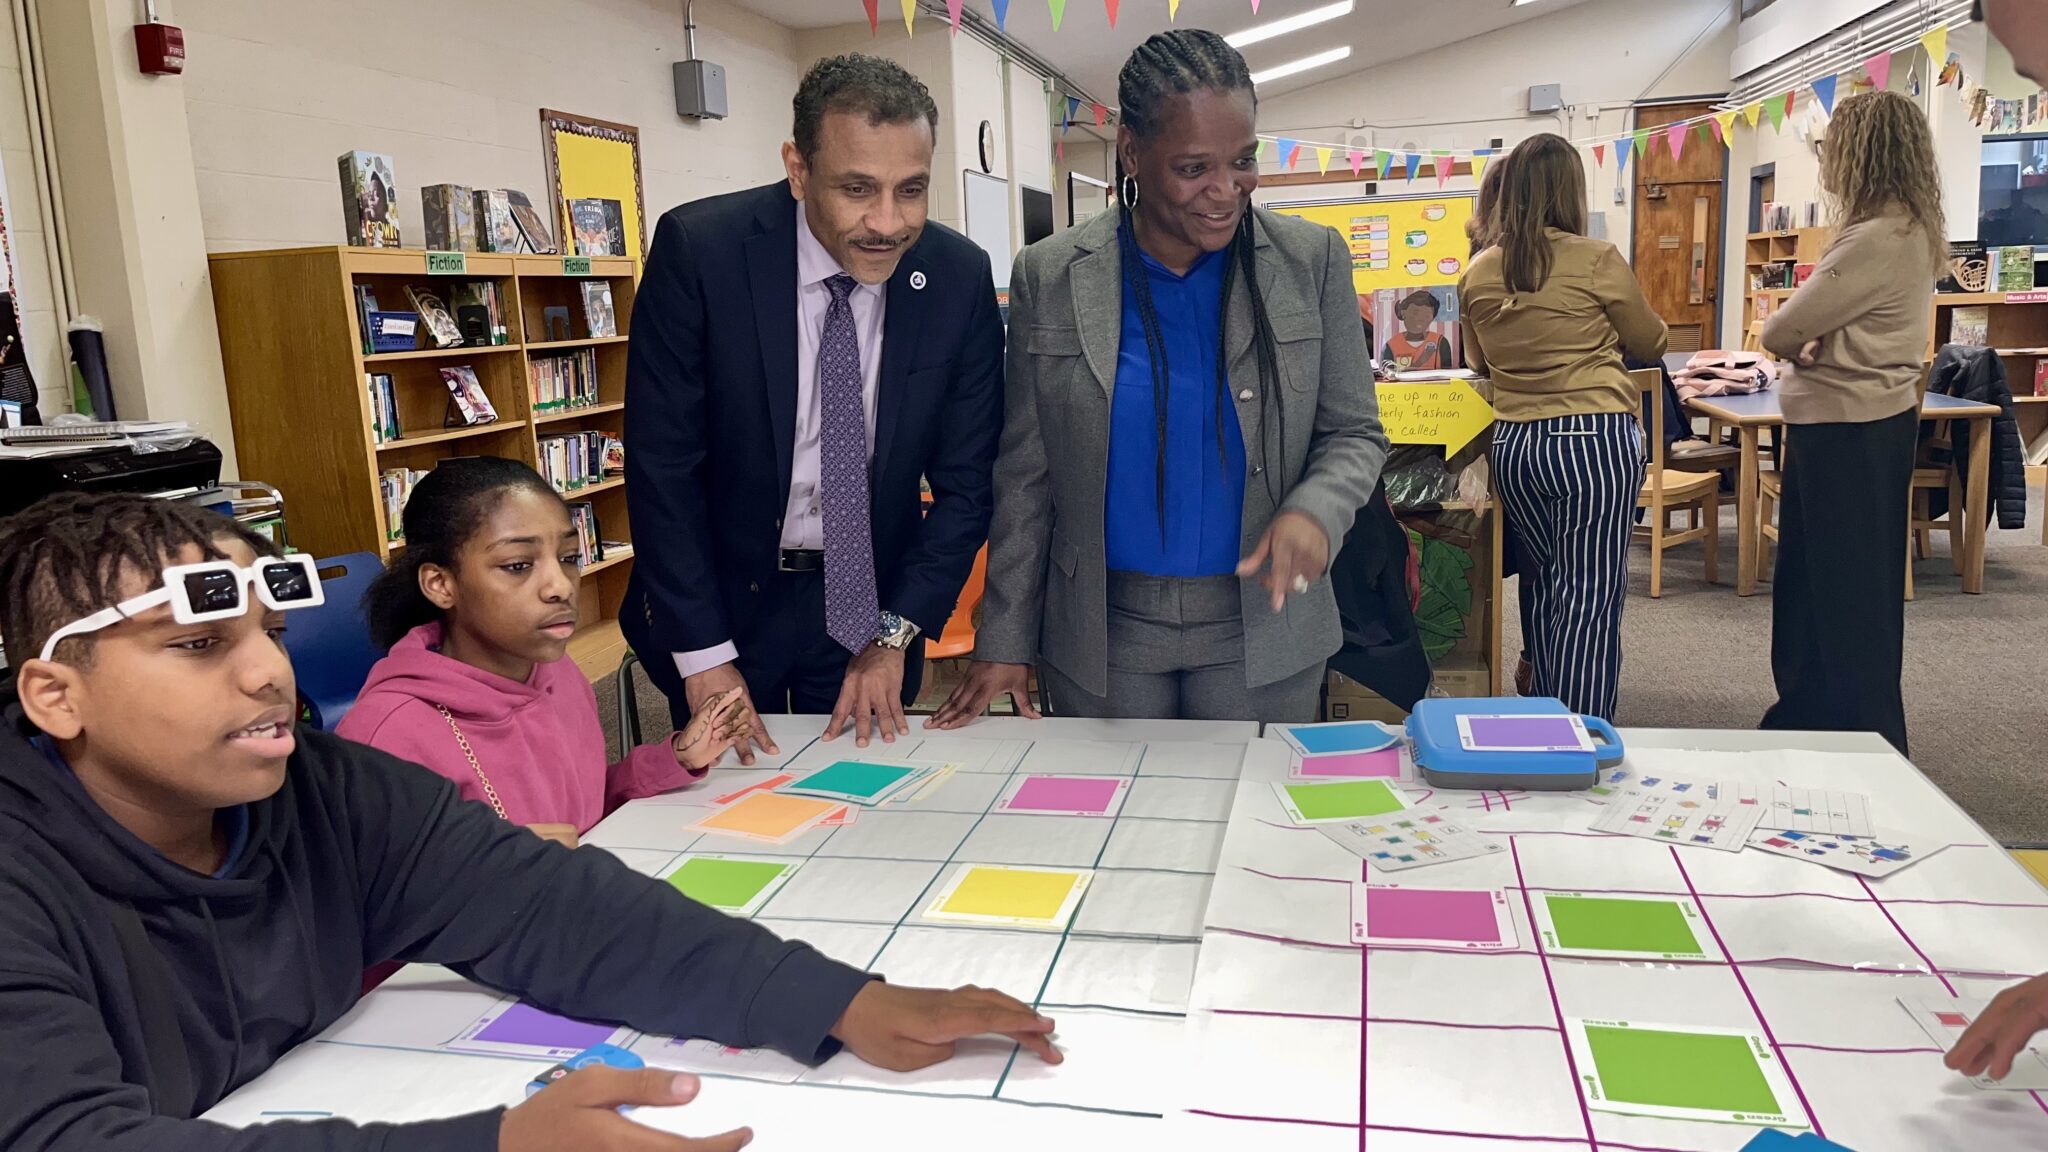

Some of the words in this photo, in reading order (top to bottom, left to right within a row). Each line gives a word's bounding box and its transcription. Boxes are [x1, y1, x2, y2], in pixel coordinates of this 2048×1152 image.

[169, 46, 184, 57] FIRE
[366, 220, 398, 239] CROWN
[429, 255, 463, 270] Fiction
[565, 260, 590, 273] Fiction
[1377, 393, 1395, 402] ne
[1403, 392, 1419, 406] up
[1429, 392, 1439, 401] in
[1448, 391, 1464, 402] an
[1378, 405, 1404, 421] derly
[1413, 405, 1460, 419] fashion
[1384, 427, 1393, 435] en
[1401, 424, 1438, 436] called
[1747, 1114, 1788, 1123] Green
